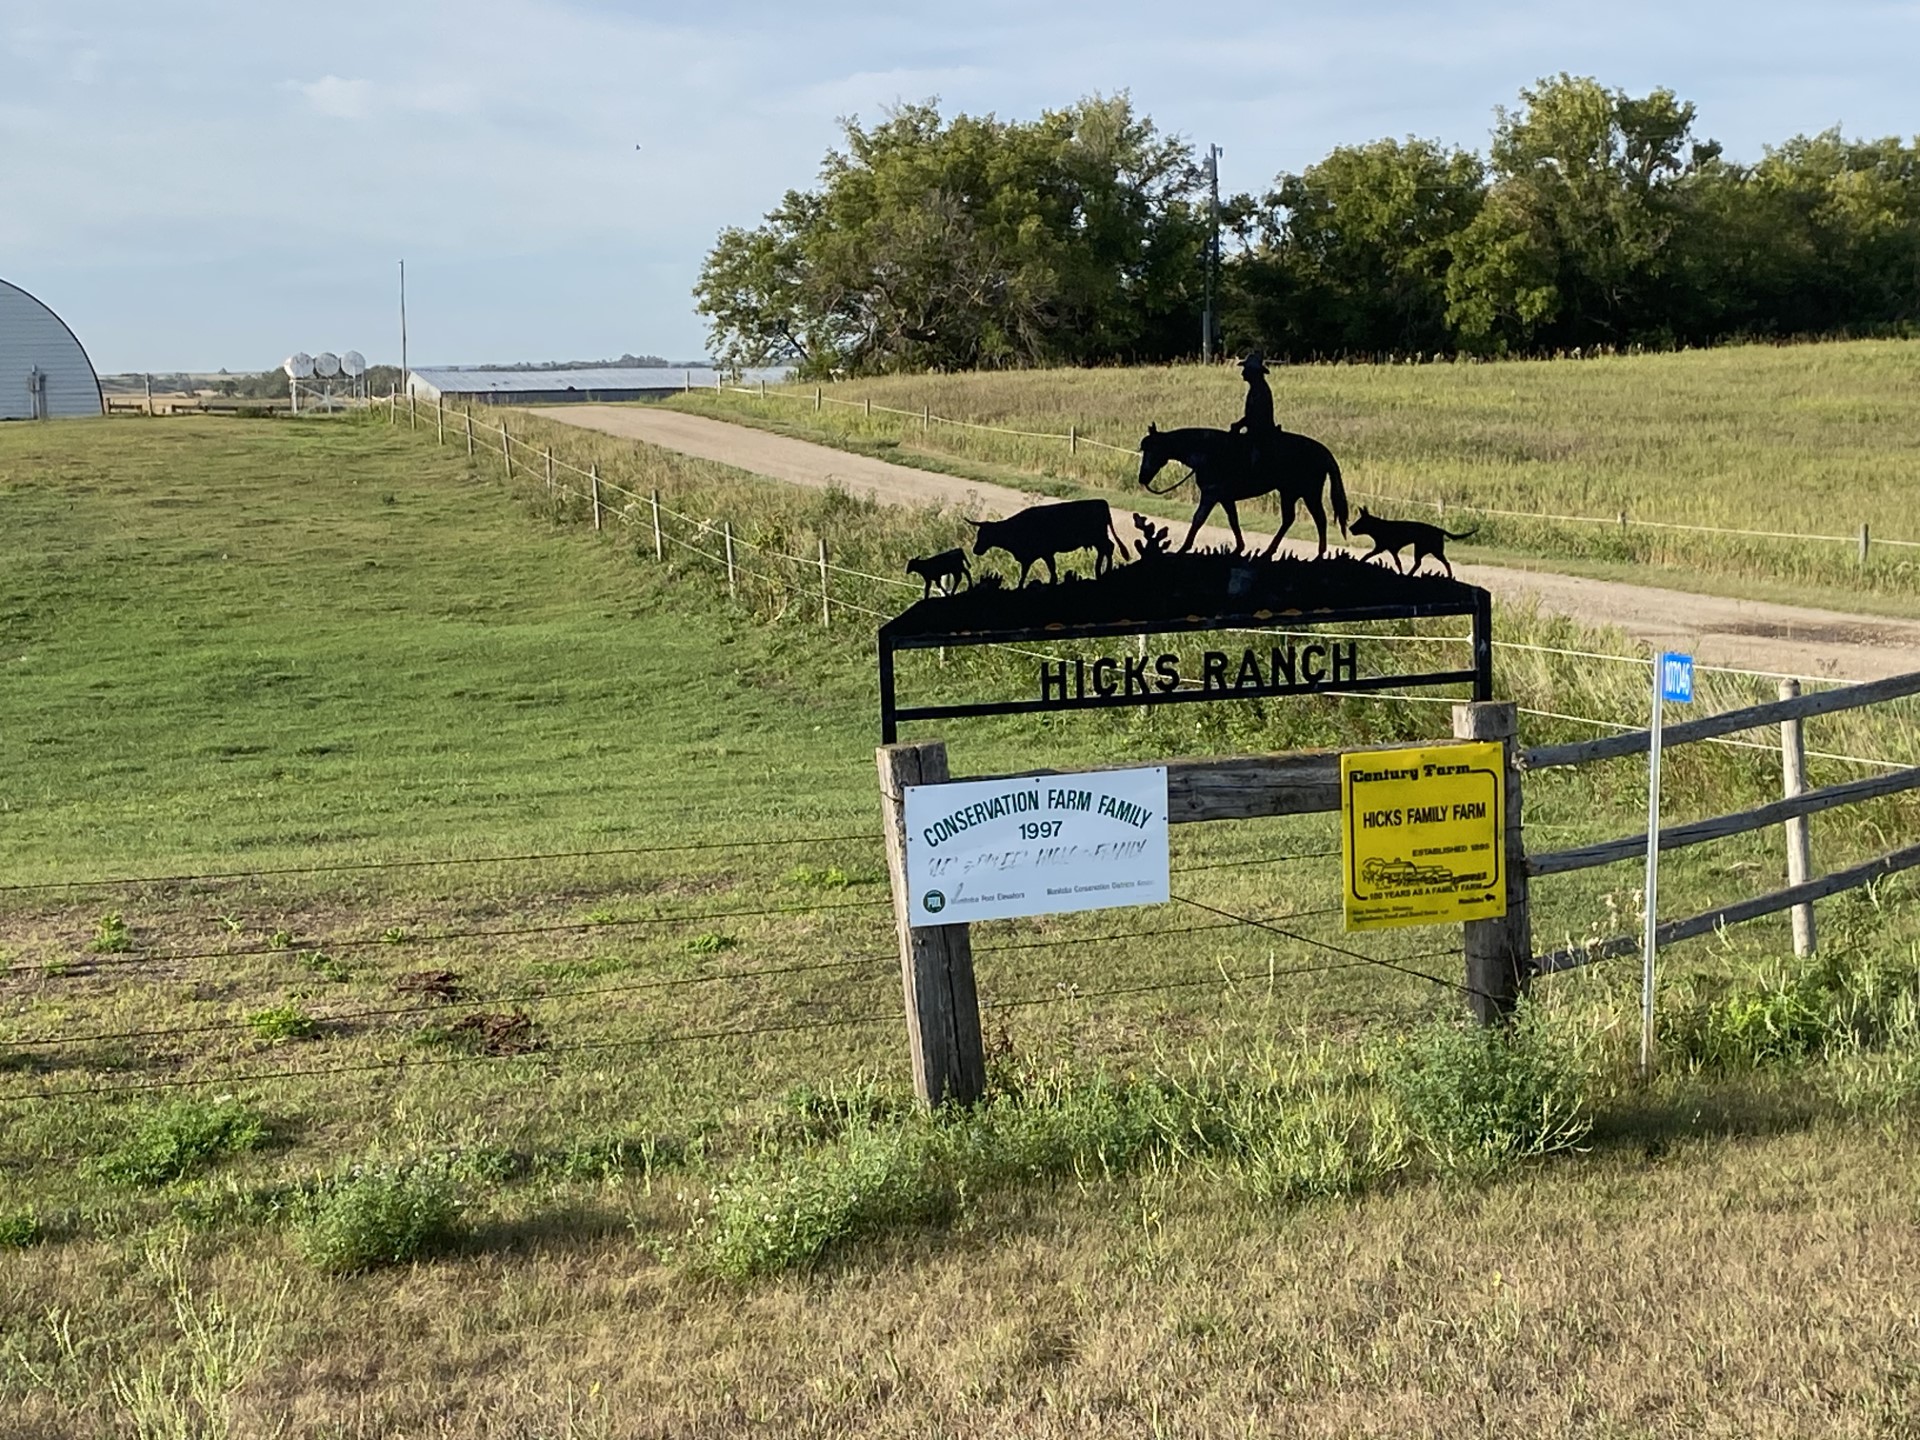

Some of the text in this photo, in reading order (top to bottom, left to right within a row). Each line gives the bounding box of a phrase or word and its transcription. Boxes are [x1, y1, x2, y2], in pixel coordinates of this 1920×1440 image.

[1040, 642, 1357, 701] HICKS RANCH
[1352, 764, 1470, 783] Century Farm
[923, 788, 1153, 848] CONSERVATION FARM FAMILY
[1363, 802, 1487, 829] HICKS FAMILY FARM
[1018, 820, 1063, 841] 1997
[1412, 844, 1468, 858] ESTABLISHED
[1385, 889, 1410, 900] YEARS
[1412, 888, 1423, 897] AS
[1425, 887, 1432, 896] A
[1433, 885, 1460, 895] FAMILY
